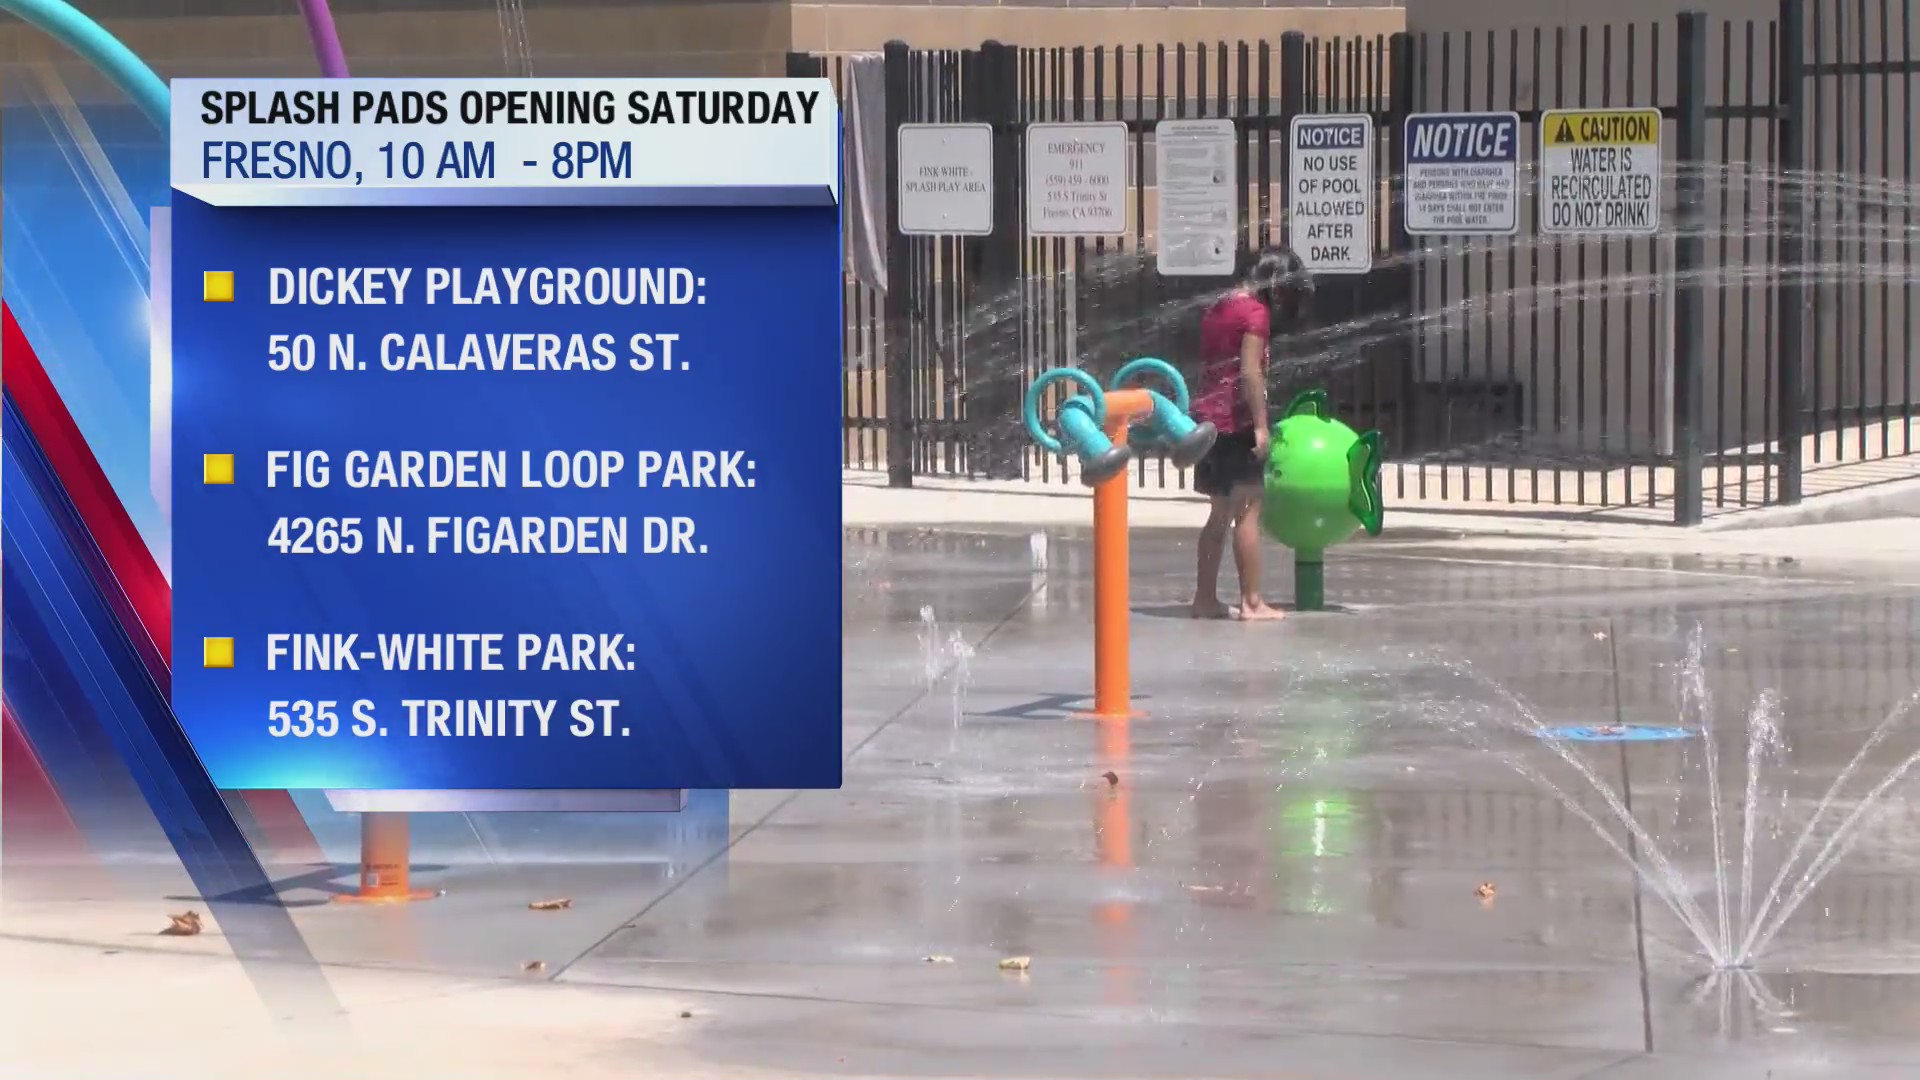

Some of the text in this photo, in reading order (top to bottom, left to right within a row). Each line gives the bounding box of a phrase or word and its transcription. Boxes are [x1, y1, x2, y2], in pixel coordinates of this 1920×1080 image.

[1299, 127, 1362, 146] NOTICE
[1581, 116, 1650, 142] CAUTION
[1047, 142, 1105, 154] EMERGENCY
[1412, 122, 1511, 158] NOTICE
[1069, 158, 1083, 169] 911
[1303, 155, 1357, 172] NO USE
[1571, 147, 1632, 173] WATER IS
[905, 181, 986, 193] SPLASH PLAY AREA
[1067, 174, 1082, 186] 459
[1298, 179, 1361, 193] OF POOL
[1551, 174, 1651, 200] RECIRCULATED
[1071, 190, 1097, 205] Trinity
[1072, 207, 1086, 219] CA
[1295, 201, 1365, 217] ALLOWED
[1552, 201, 1650, 227] DO NOT DRINK!
[1307, 223, 1353, 239] AFTER
